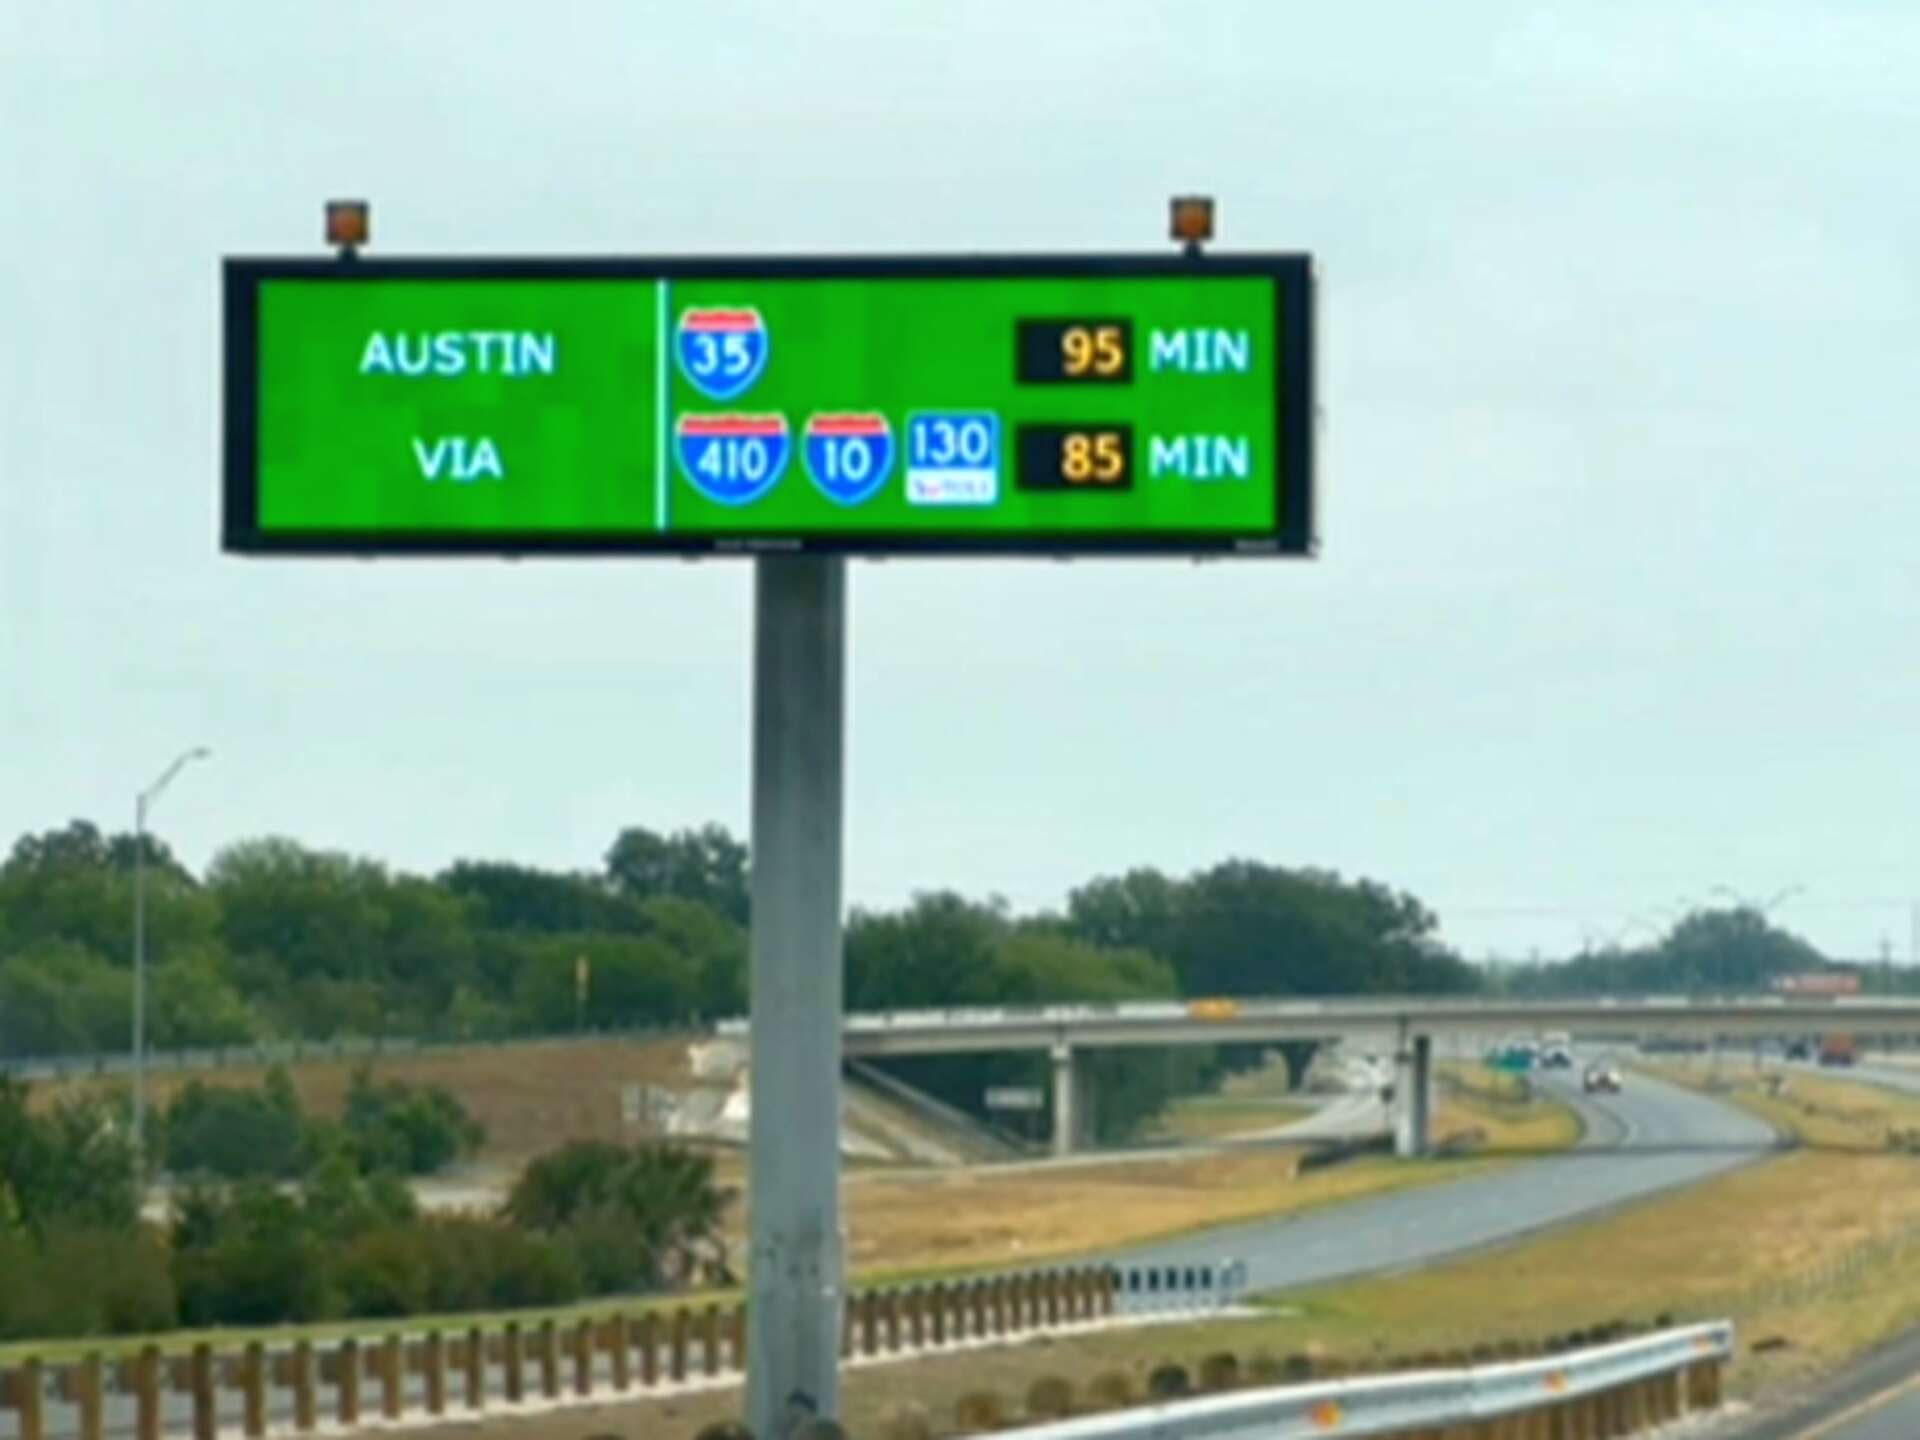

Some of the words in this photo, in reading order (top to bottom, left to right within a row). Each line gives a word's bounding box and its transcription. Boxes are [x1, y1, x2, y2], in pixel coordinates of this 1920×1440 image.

[359, 330, 554, 374] AUSTIN
[693, 334, 751, 376] 35
[1061, 327, 1124, 375] 95
[1149, 328, 1249, 373] MIN
[412, 436, 503, 480] VIA
[698, 439, 768, 481] 410
[824, 439, 871, 481] 10
[915, 421, 989, 463] 130
[1061, 434, 1124, 480] 85
[1149, 435, 1249, 479] MIN
